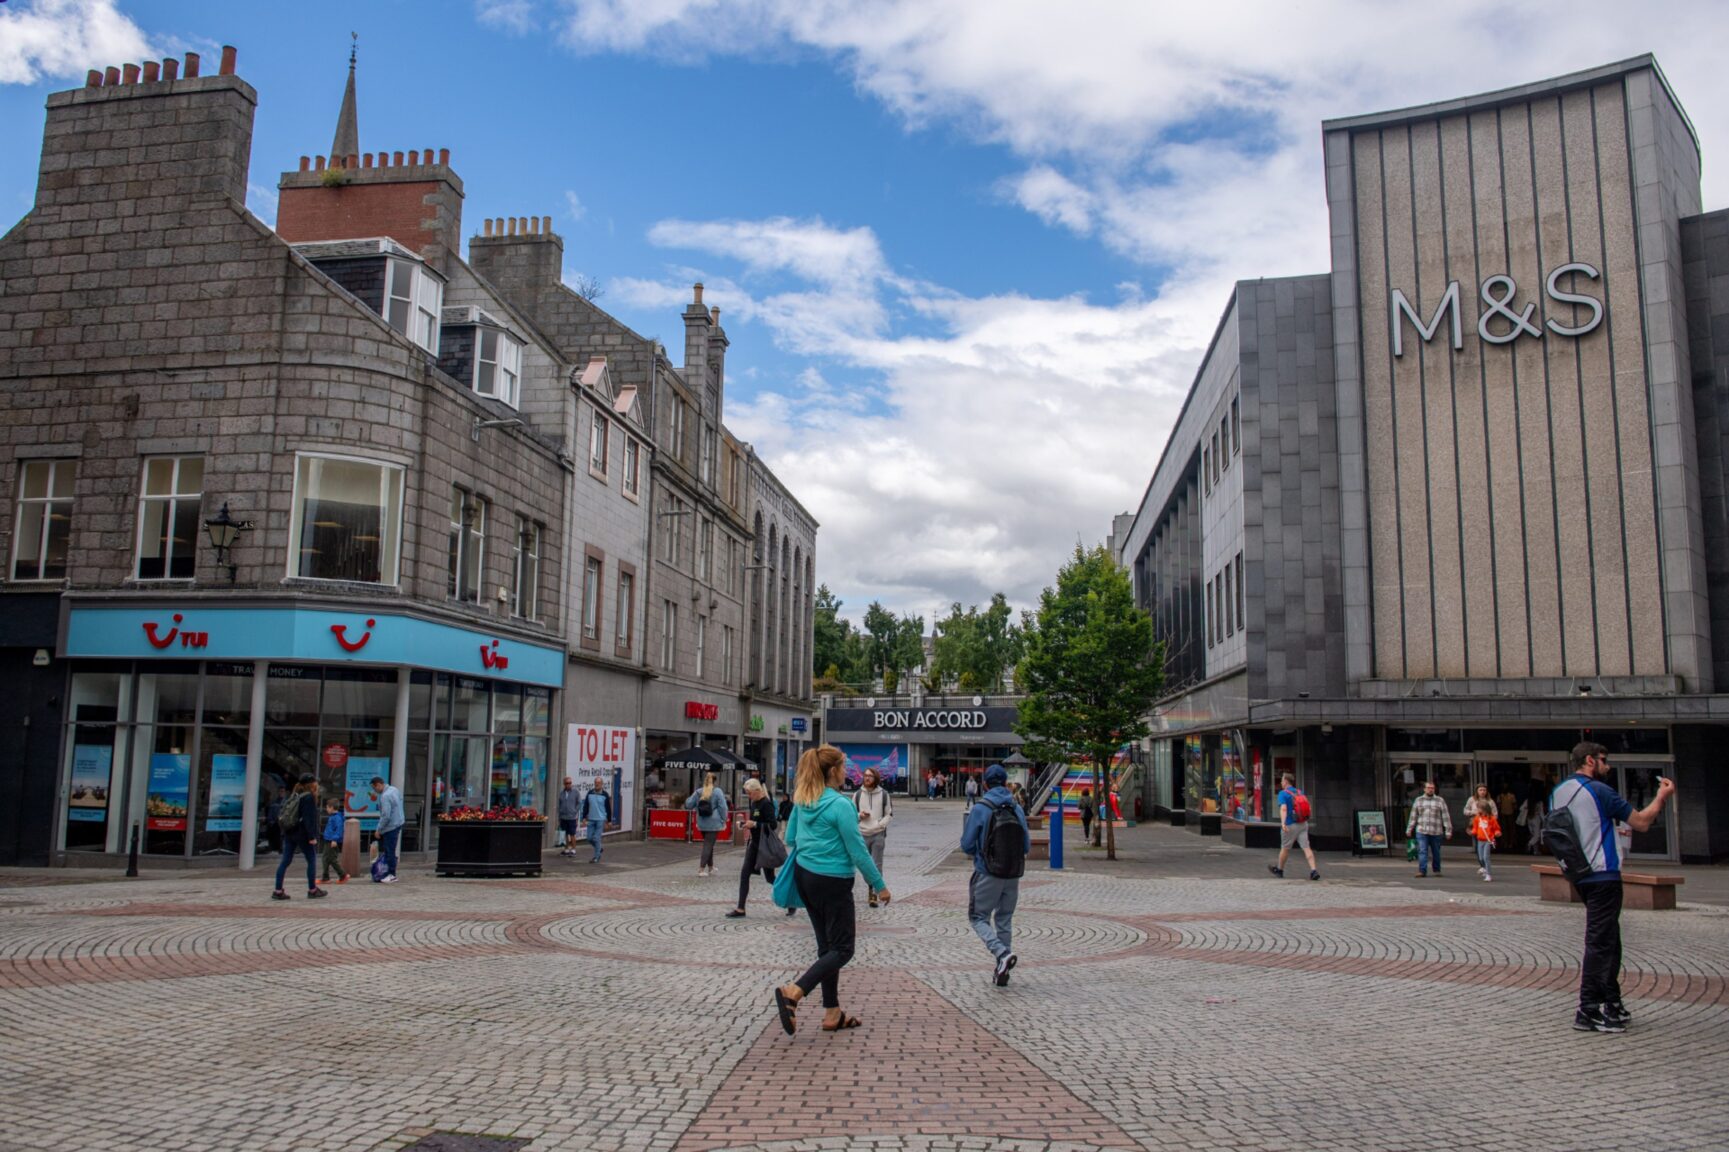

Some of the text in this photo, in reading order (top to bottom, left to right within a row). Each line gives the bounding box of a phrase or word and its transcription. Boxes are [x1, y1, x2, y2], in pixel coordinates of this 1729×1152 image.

[1390, 261, 1605, 359] M&S
[180, 632, 209, 648] TUI
[232, 665, 256, 675] TRAV
[270, 666, 304, 677] MONEY
[873, 711, 987, 728] BON ACCORD
[577, 728, 628, 763] TO LET
[664, 761, 711, 770] FIVE GUYS
